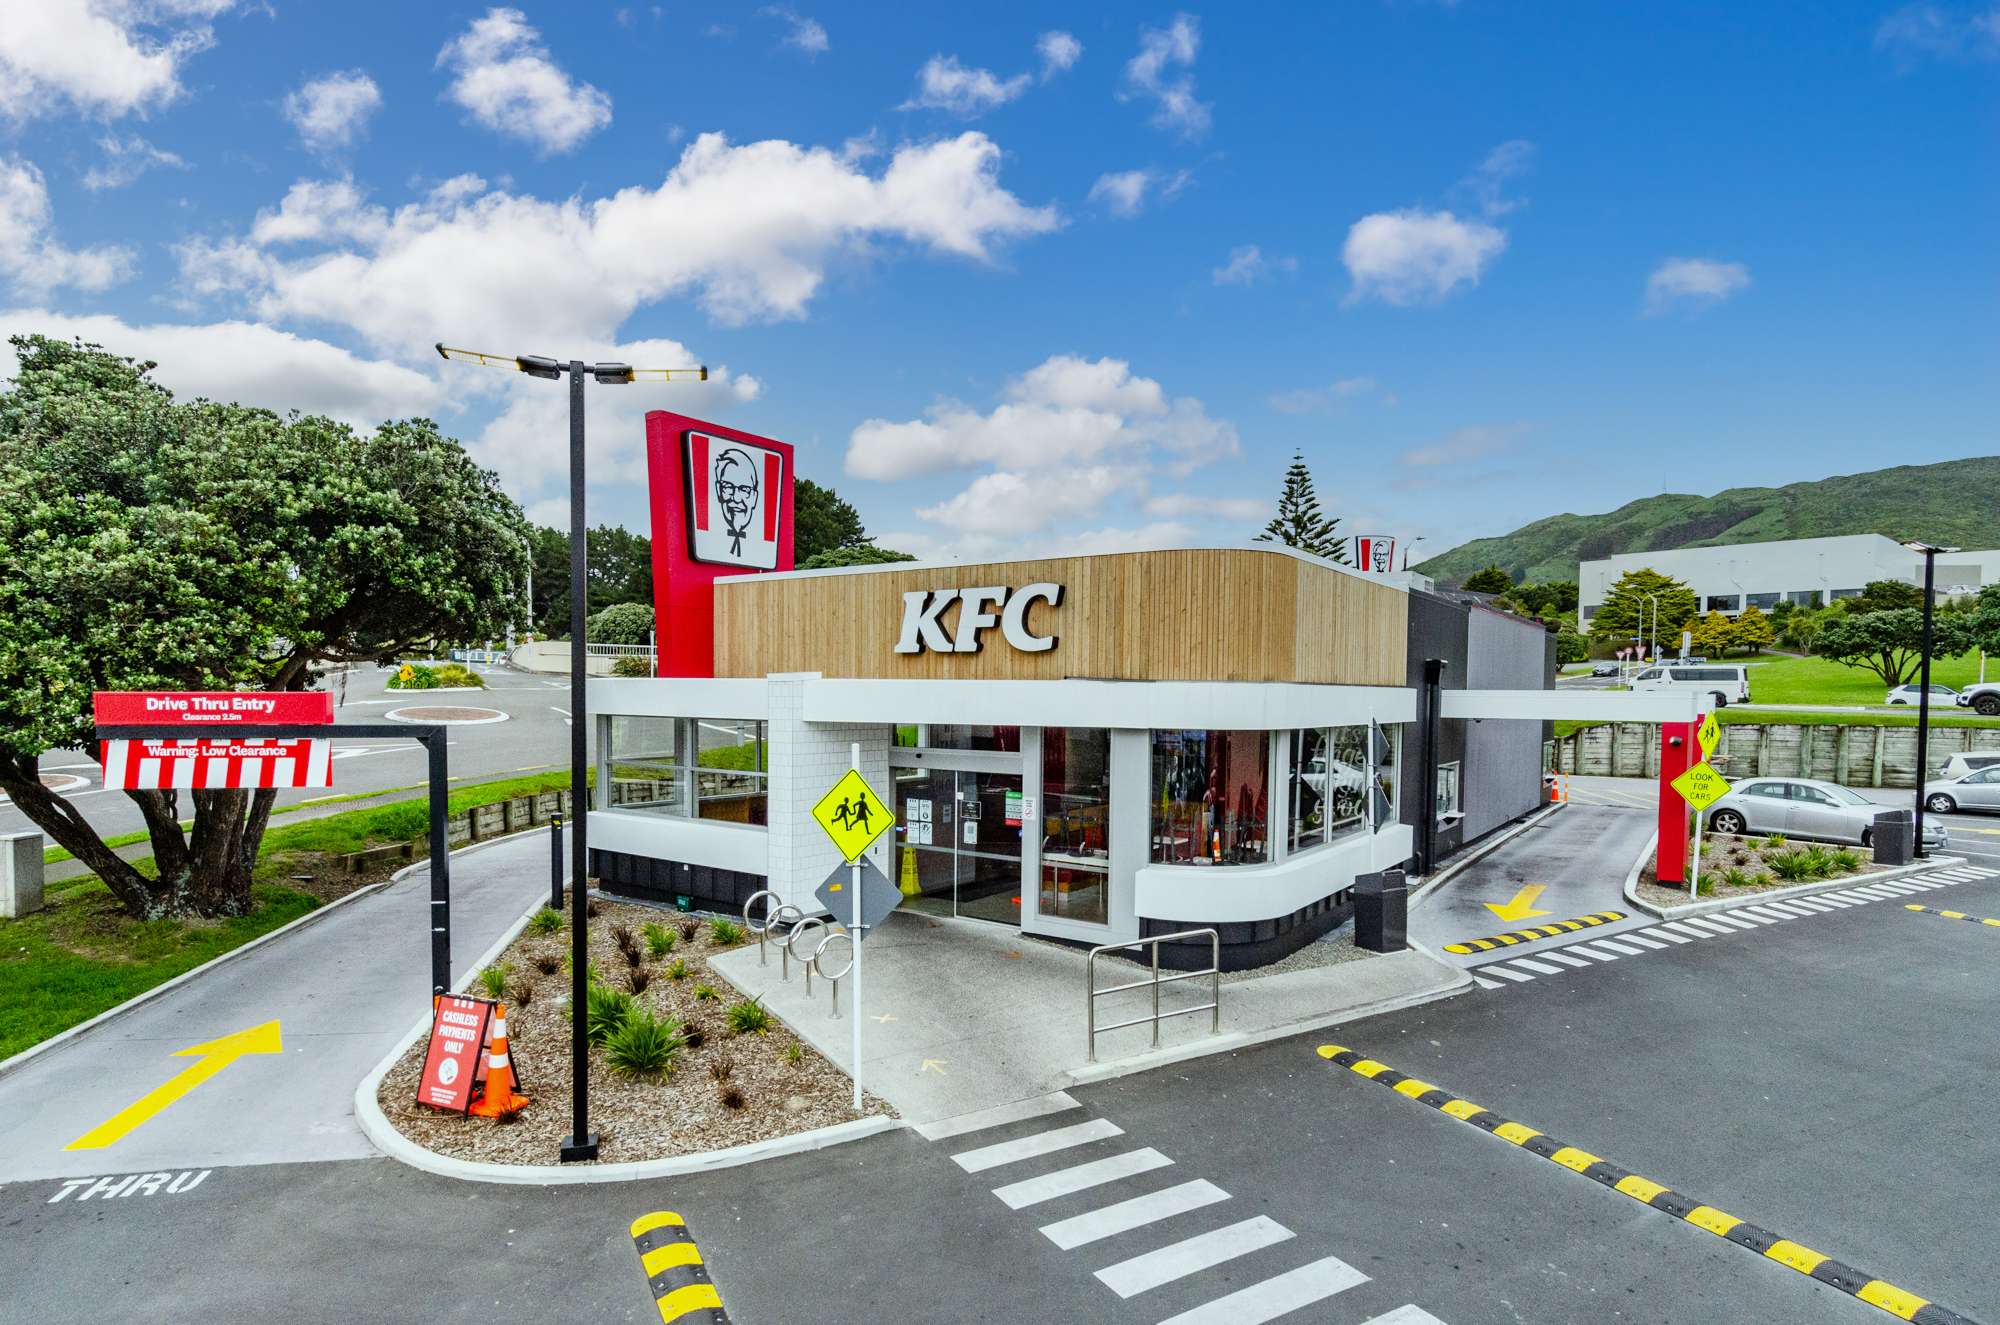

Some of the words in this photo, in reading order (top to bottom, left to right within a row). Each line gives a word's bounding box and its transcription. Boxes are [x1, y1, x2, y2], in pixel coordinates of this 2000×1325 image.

[894, 582, 1063, 655] KFC
[146, 697, 188, 710] Drive
[191, 697, 229, 710] Thru
[231, 697, 275, 713] Entry
[182, 713, 221, 721] Clearance
[222, 713, 242, 721] 2.5m
[148, 745, 199, 759] Warning:
[202, 746, 226, 757] Low
[228, 745, 287, 757] Clearance
[1690, 773, 1713, 781] LOOK
[1693, 782, 1709, 791] FOR
[1689, 792, 1711, 801] CARS
[442, 1010, 479, 1027] CASHLESS
[438, 1024, 477, 1042] PAYMENTS
[444, 1040, 464, 1055] ONLY
[48, 1170, 212, 1203] THRU
